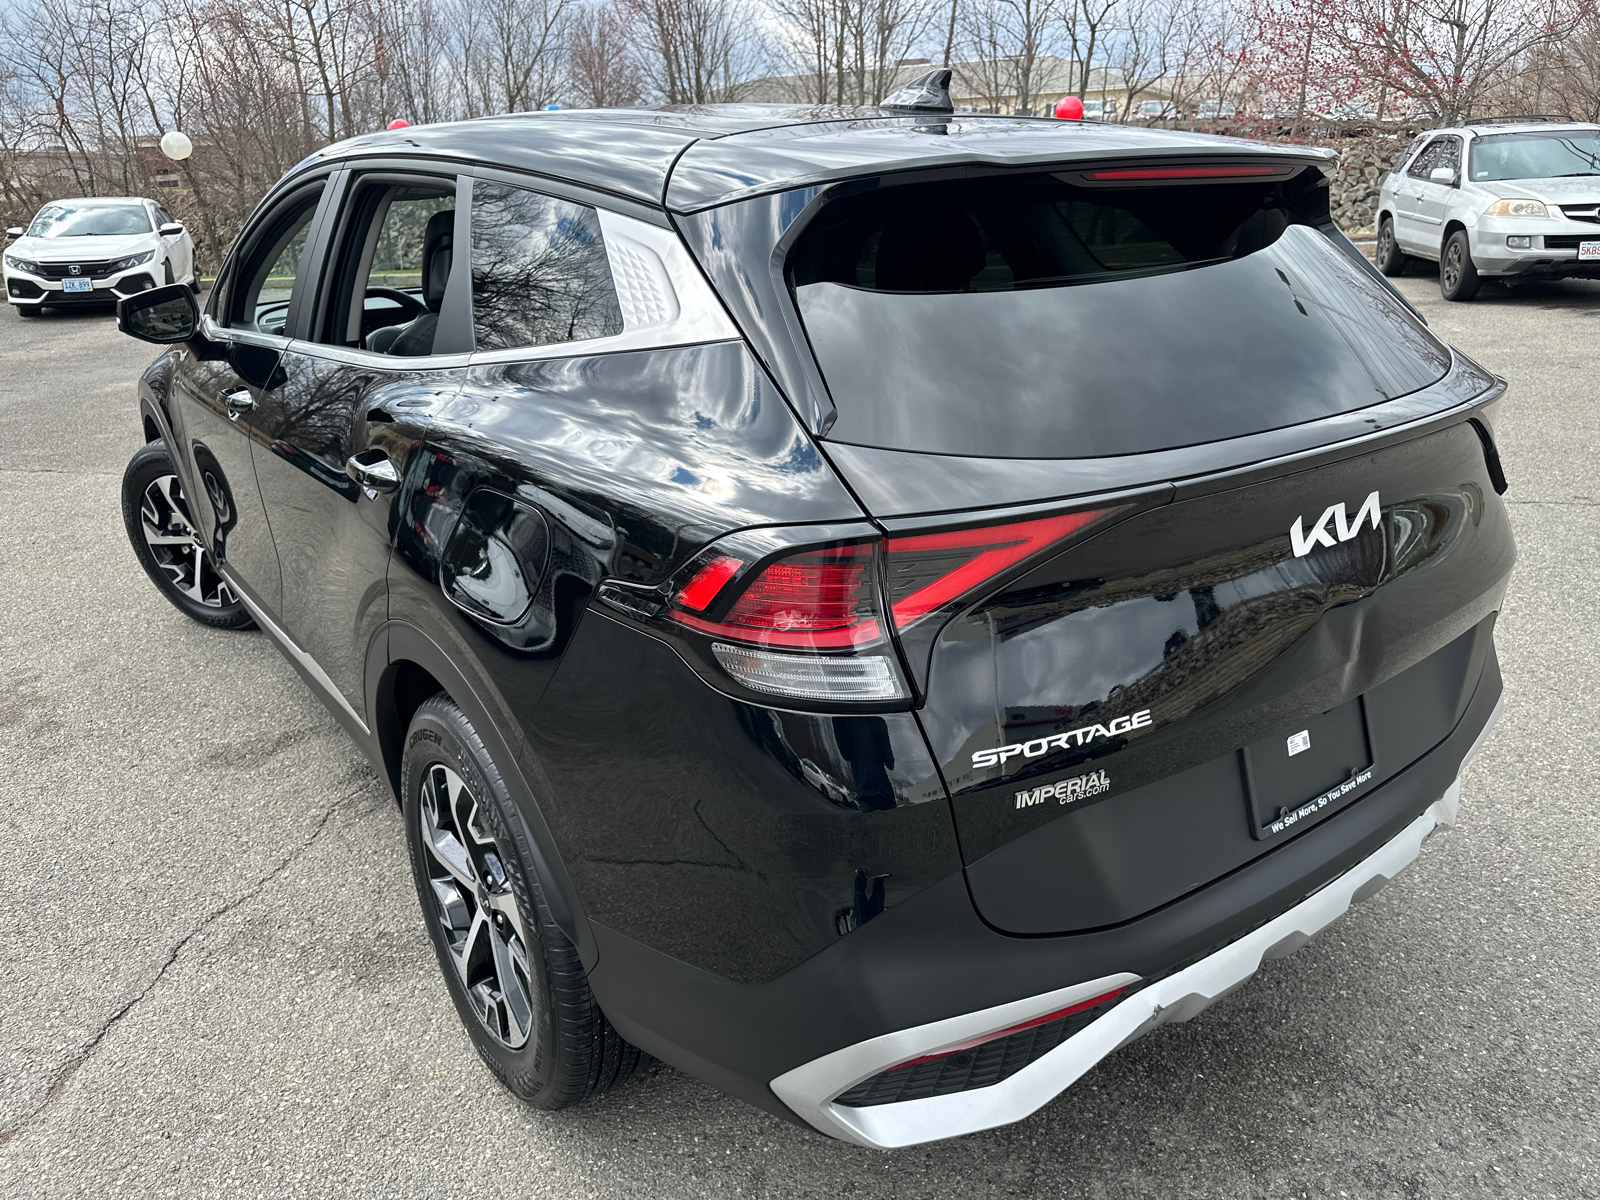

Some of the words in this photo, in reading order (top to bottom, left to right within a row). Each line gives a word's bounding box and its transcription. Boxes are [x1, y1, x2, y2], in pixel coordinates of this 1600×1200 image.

[1290, 490, 1381, 558] KIA
[972, 709, 1152, 768] SPORTAGE
[1014, 769, 1110, 809] IMPERIAL
[1059, 781, 1110, 805] cars.com
[1271, 822, 1284, 834] We
[1284, 813, 1298, 827] Sell
[1298, 804, 1318, 819] More,
[1318, 797, 1328, 808] So
[1327, 790, 1341, 802] You
[1340, 780, 1357, 795] Save
[1356, 771, 1372, 786] More
